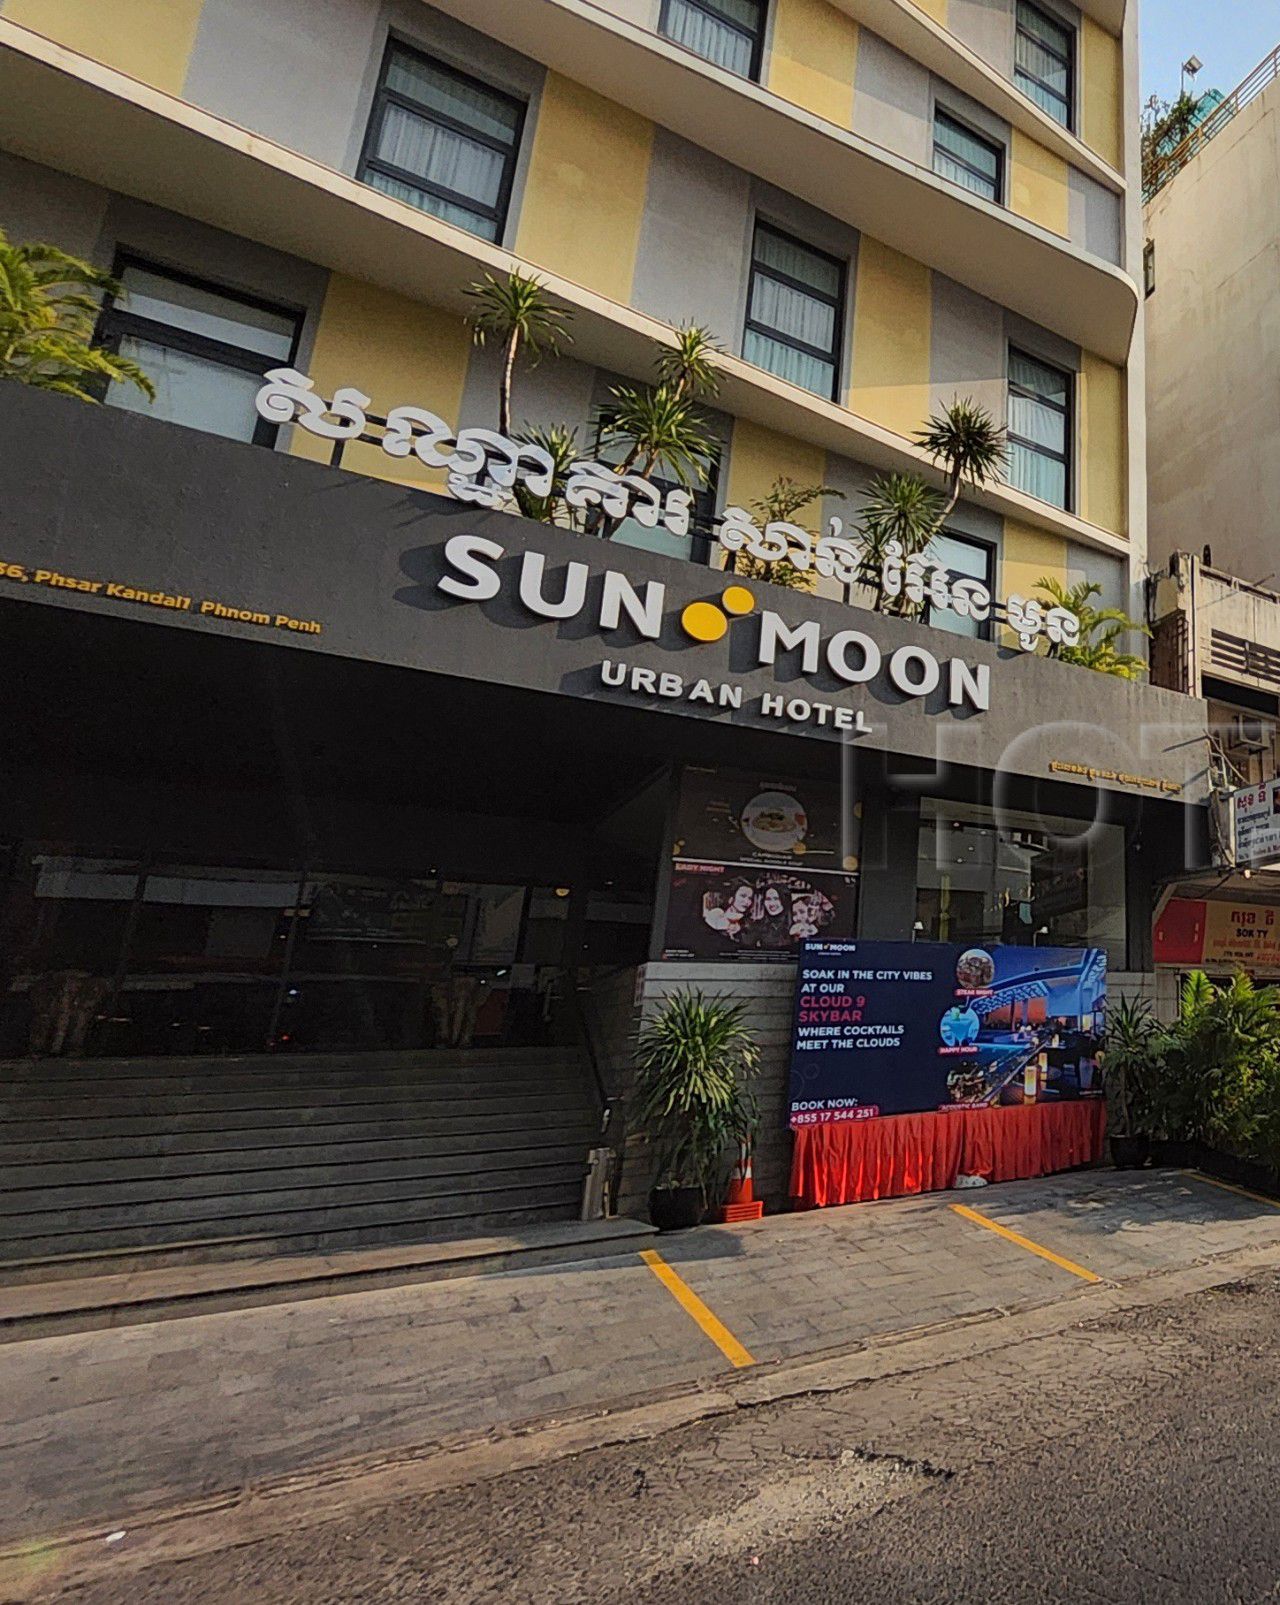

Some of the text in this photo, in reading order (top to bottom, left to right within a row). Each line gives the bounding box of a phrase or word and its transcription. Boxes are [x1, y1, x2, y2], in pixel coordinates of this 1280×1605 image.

[35, 569, 103, 594] Phsar
[201, 601, 271, 626] Phnom
[273, 614, 322, 635] Penh
[437, 535, 990, 711] SUN MOON
[601, 660, 873, 734] URBAN HOTEL
[802, 969, 933, 981] SOAK IN THE CITY VIBES
[801, 984, 845, 993] AT OUR
[800, 995, 866, 1008] CLOUD 9
[798, 1010, 862, 1023] SKYBAR
[798, 1025, 904, 1037] WHERE COCKTAILS
[796, 1037, 900, 1050] MEET THE CLOUDS
[791, 1098, 858, 1111] BOOK NOW:
[790, 1108, 874, 1124] +855 17 544 251
